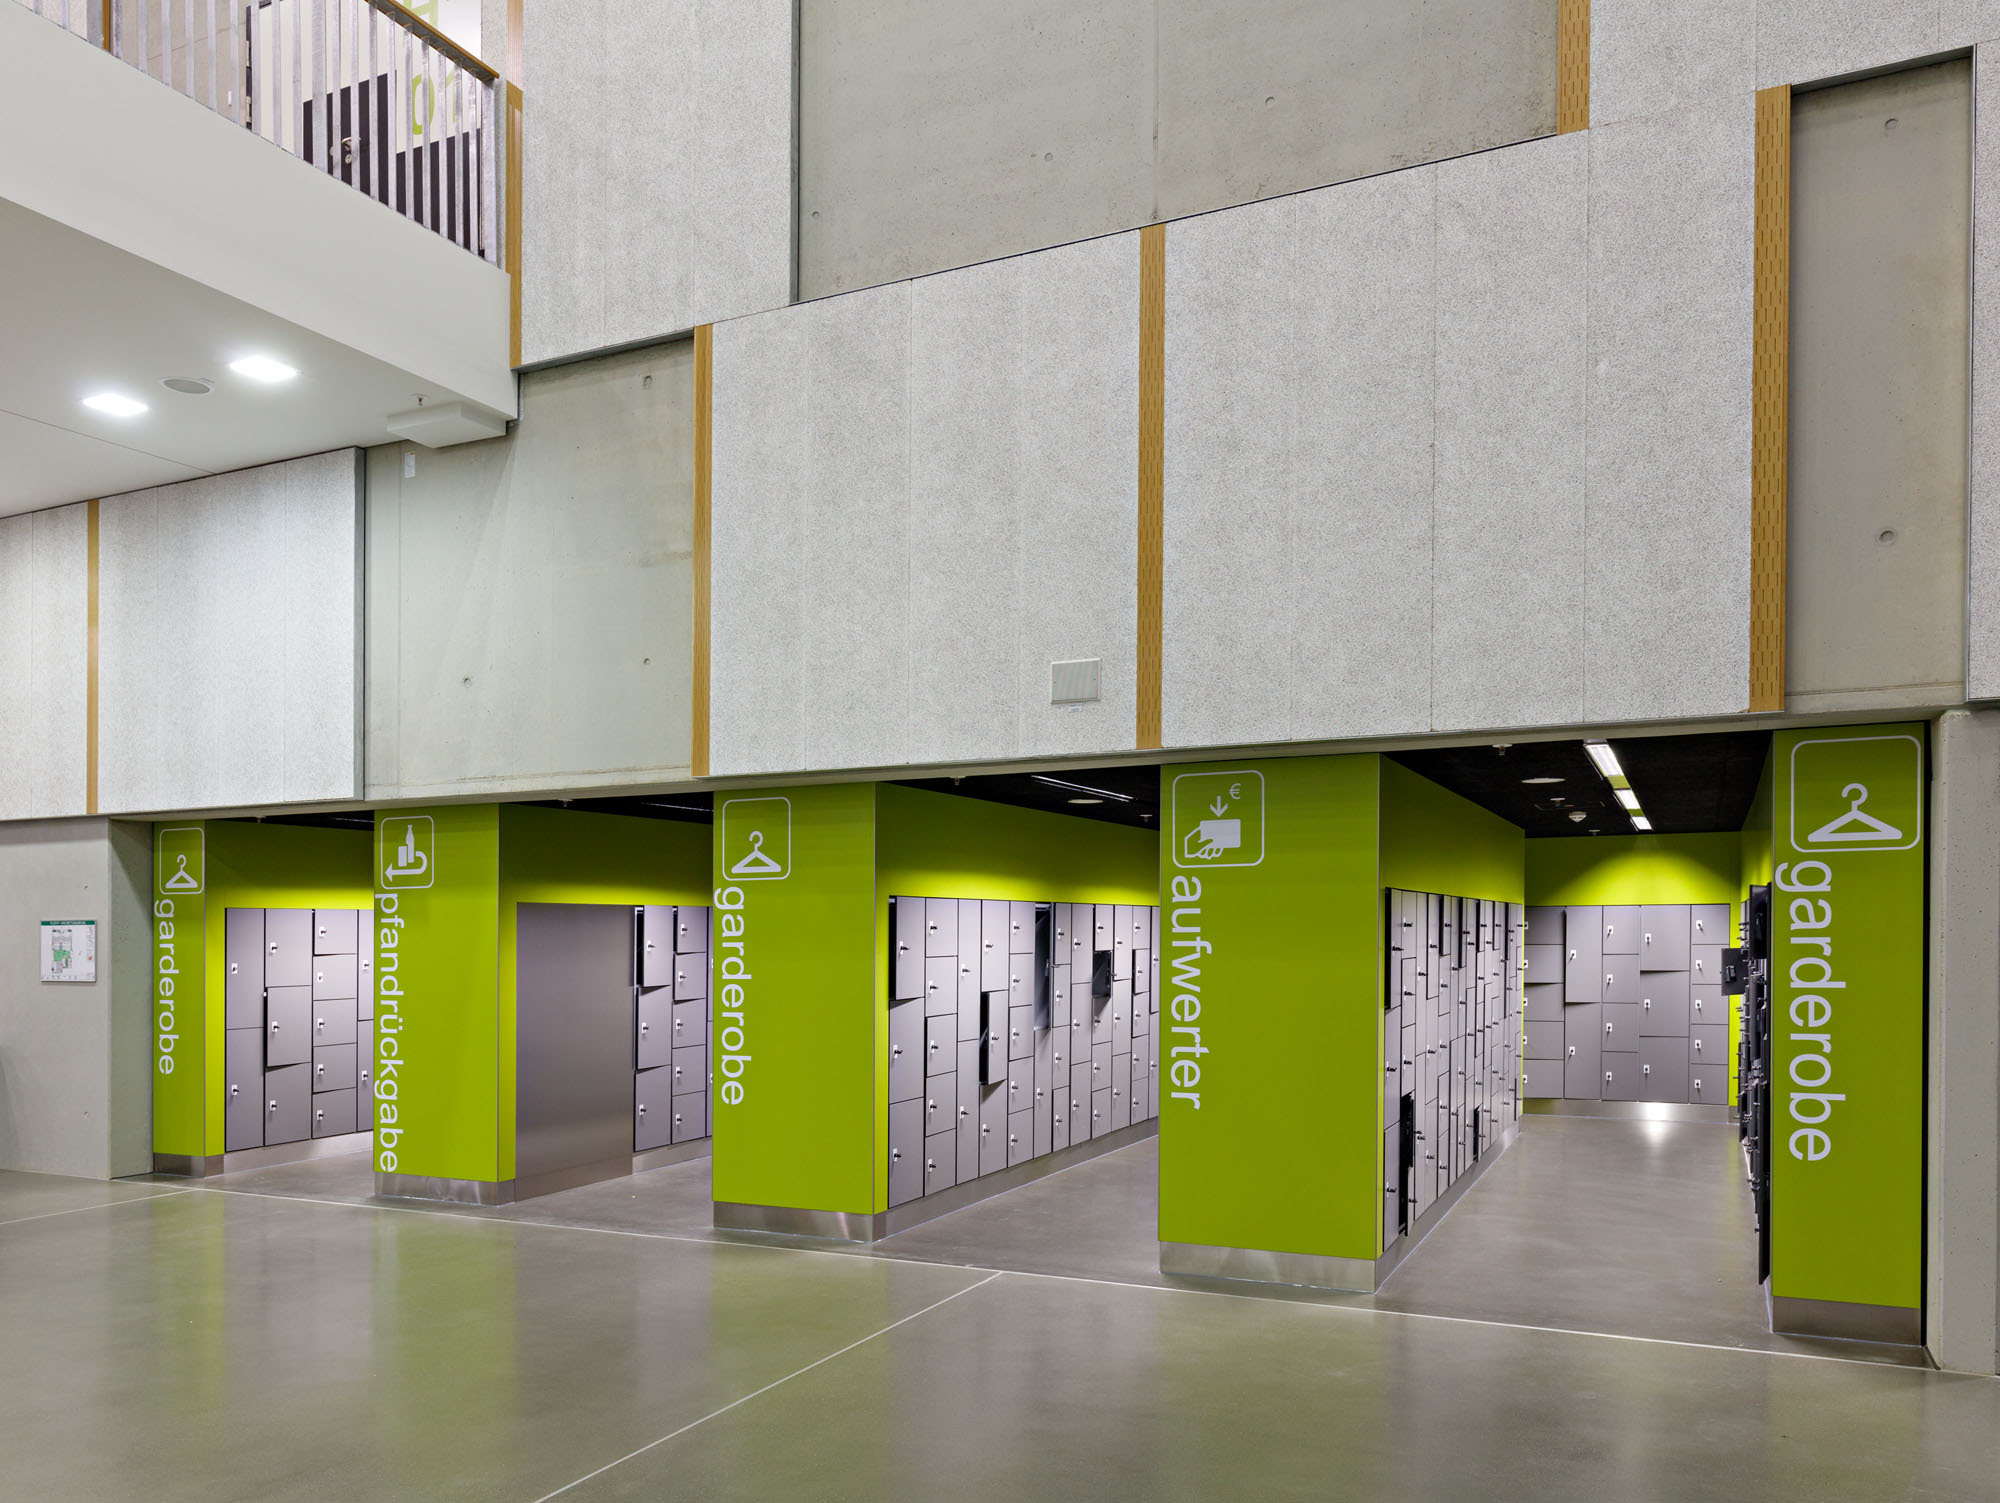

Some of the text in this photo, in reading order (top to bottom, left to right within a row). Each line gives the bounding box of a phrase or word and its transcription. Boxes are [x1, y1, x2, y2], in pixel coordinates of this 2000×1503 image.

[154, 898, 180, 1075] garderobe
[374, 893, 405, 1173] pfandrückgabe
[713, 887, 753, 1105] garderobe
[1170, 875, 1211, 1110] aufwerter
[1775, 860, 1846, 1161] garderobe
